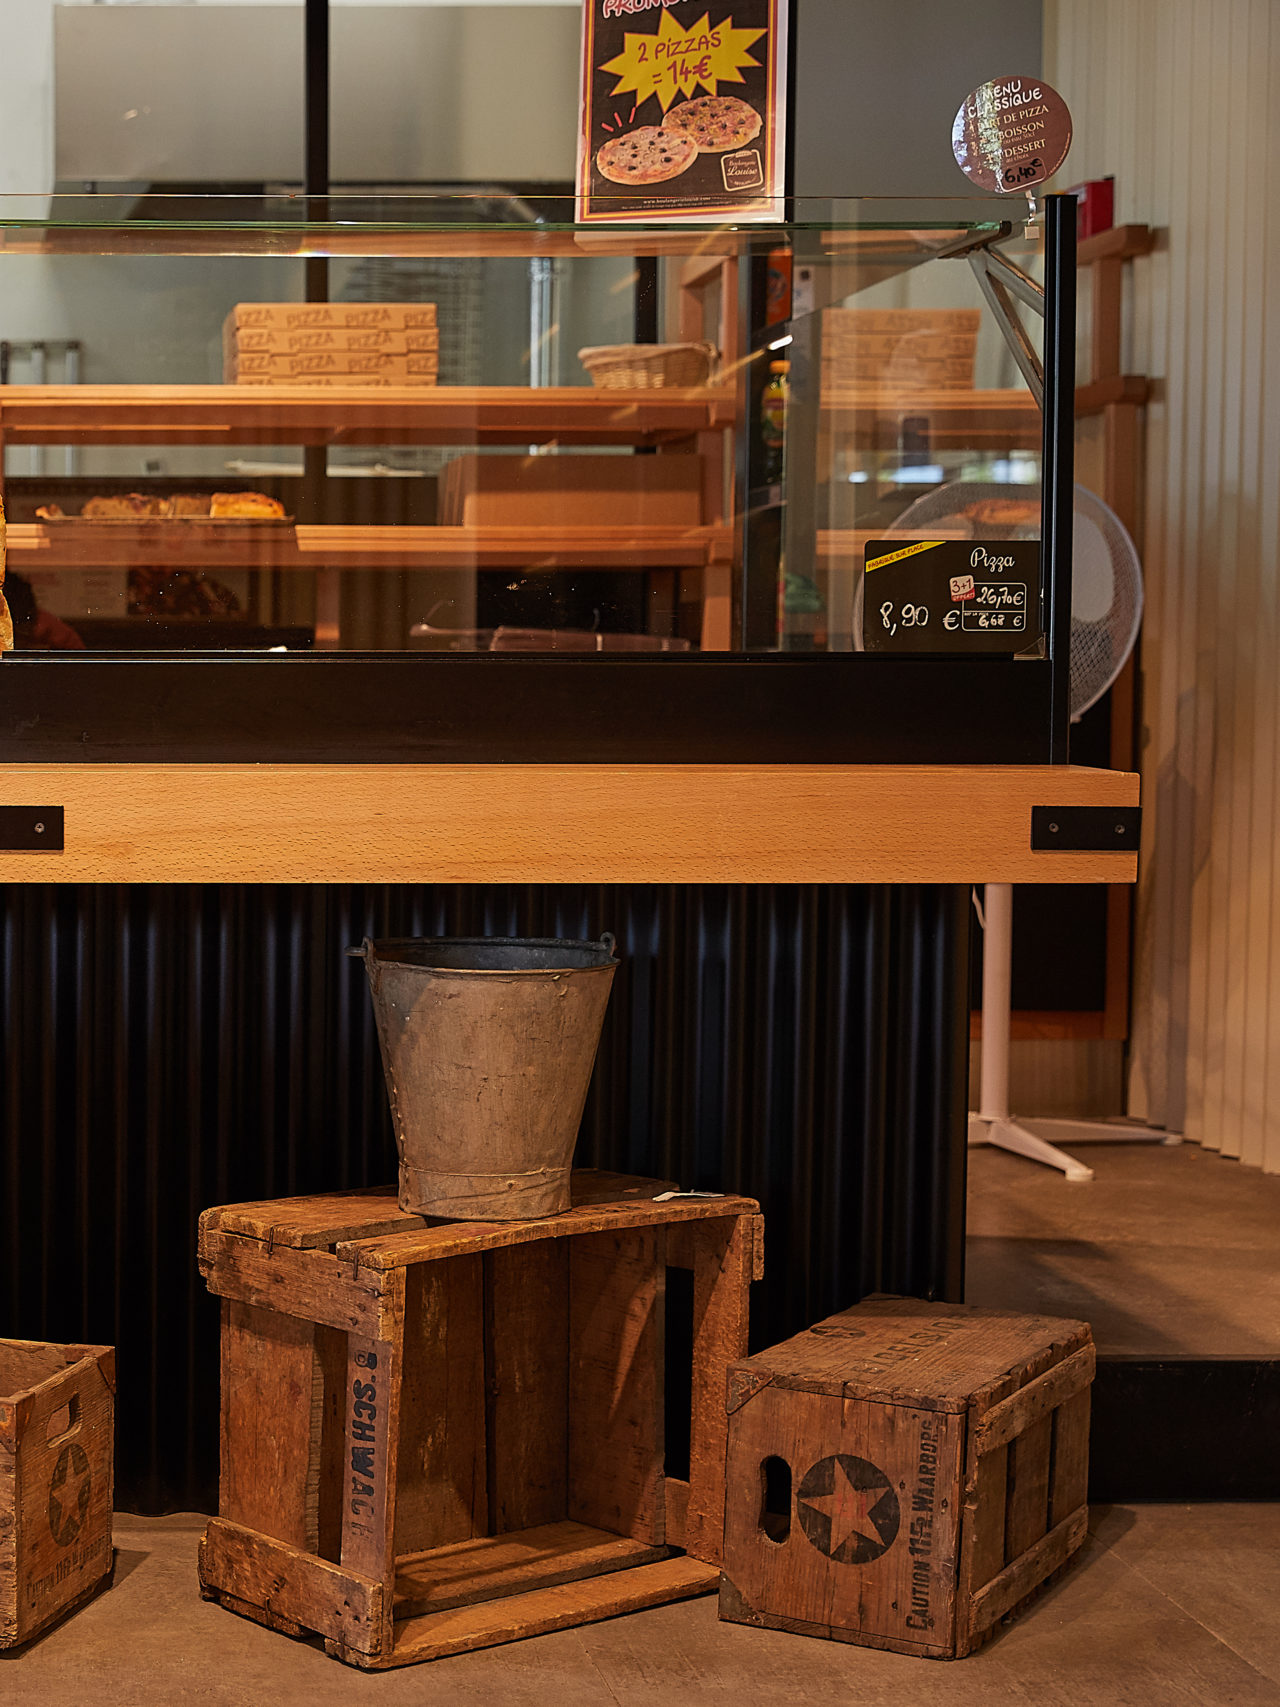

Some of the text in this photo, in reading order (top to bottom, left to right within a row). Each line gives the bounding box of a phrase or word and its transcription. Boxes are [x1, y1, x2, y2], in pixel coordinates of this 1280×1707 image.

[638, 43, 648, 63] 2
[667, 55, 713, 85] 14€
[982, 80, 1022, 101] MENU
[1004, 113, 1018, 124] DE
[1020, 104, 1049, 120] PIZZA
[999, 120, 1045, 140] BOISSON
[1004, 138, 1046, 158] DESSERT
[287, 308, 333, 328] PIZZA
[345, 308, 391, 328] PIZZA
[288, 331, 335, 350] PIZZA
[347, 330, 393, 351] PIZZA
[289, 353, 336, 373] PIZZA
[347, 354, 395, 374] PIZZA
[970, 547, 1015, 573] Pizza
[952, 578, 972, 593] 3+1
[880, 601, 960, 636] 8,90 €
[1013, 615, 1022, 627] €
[906, 1561, 933, 1632] CAUTION
